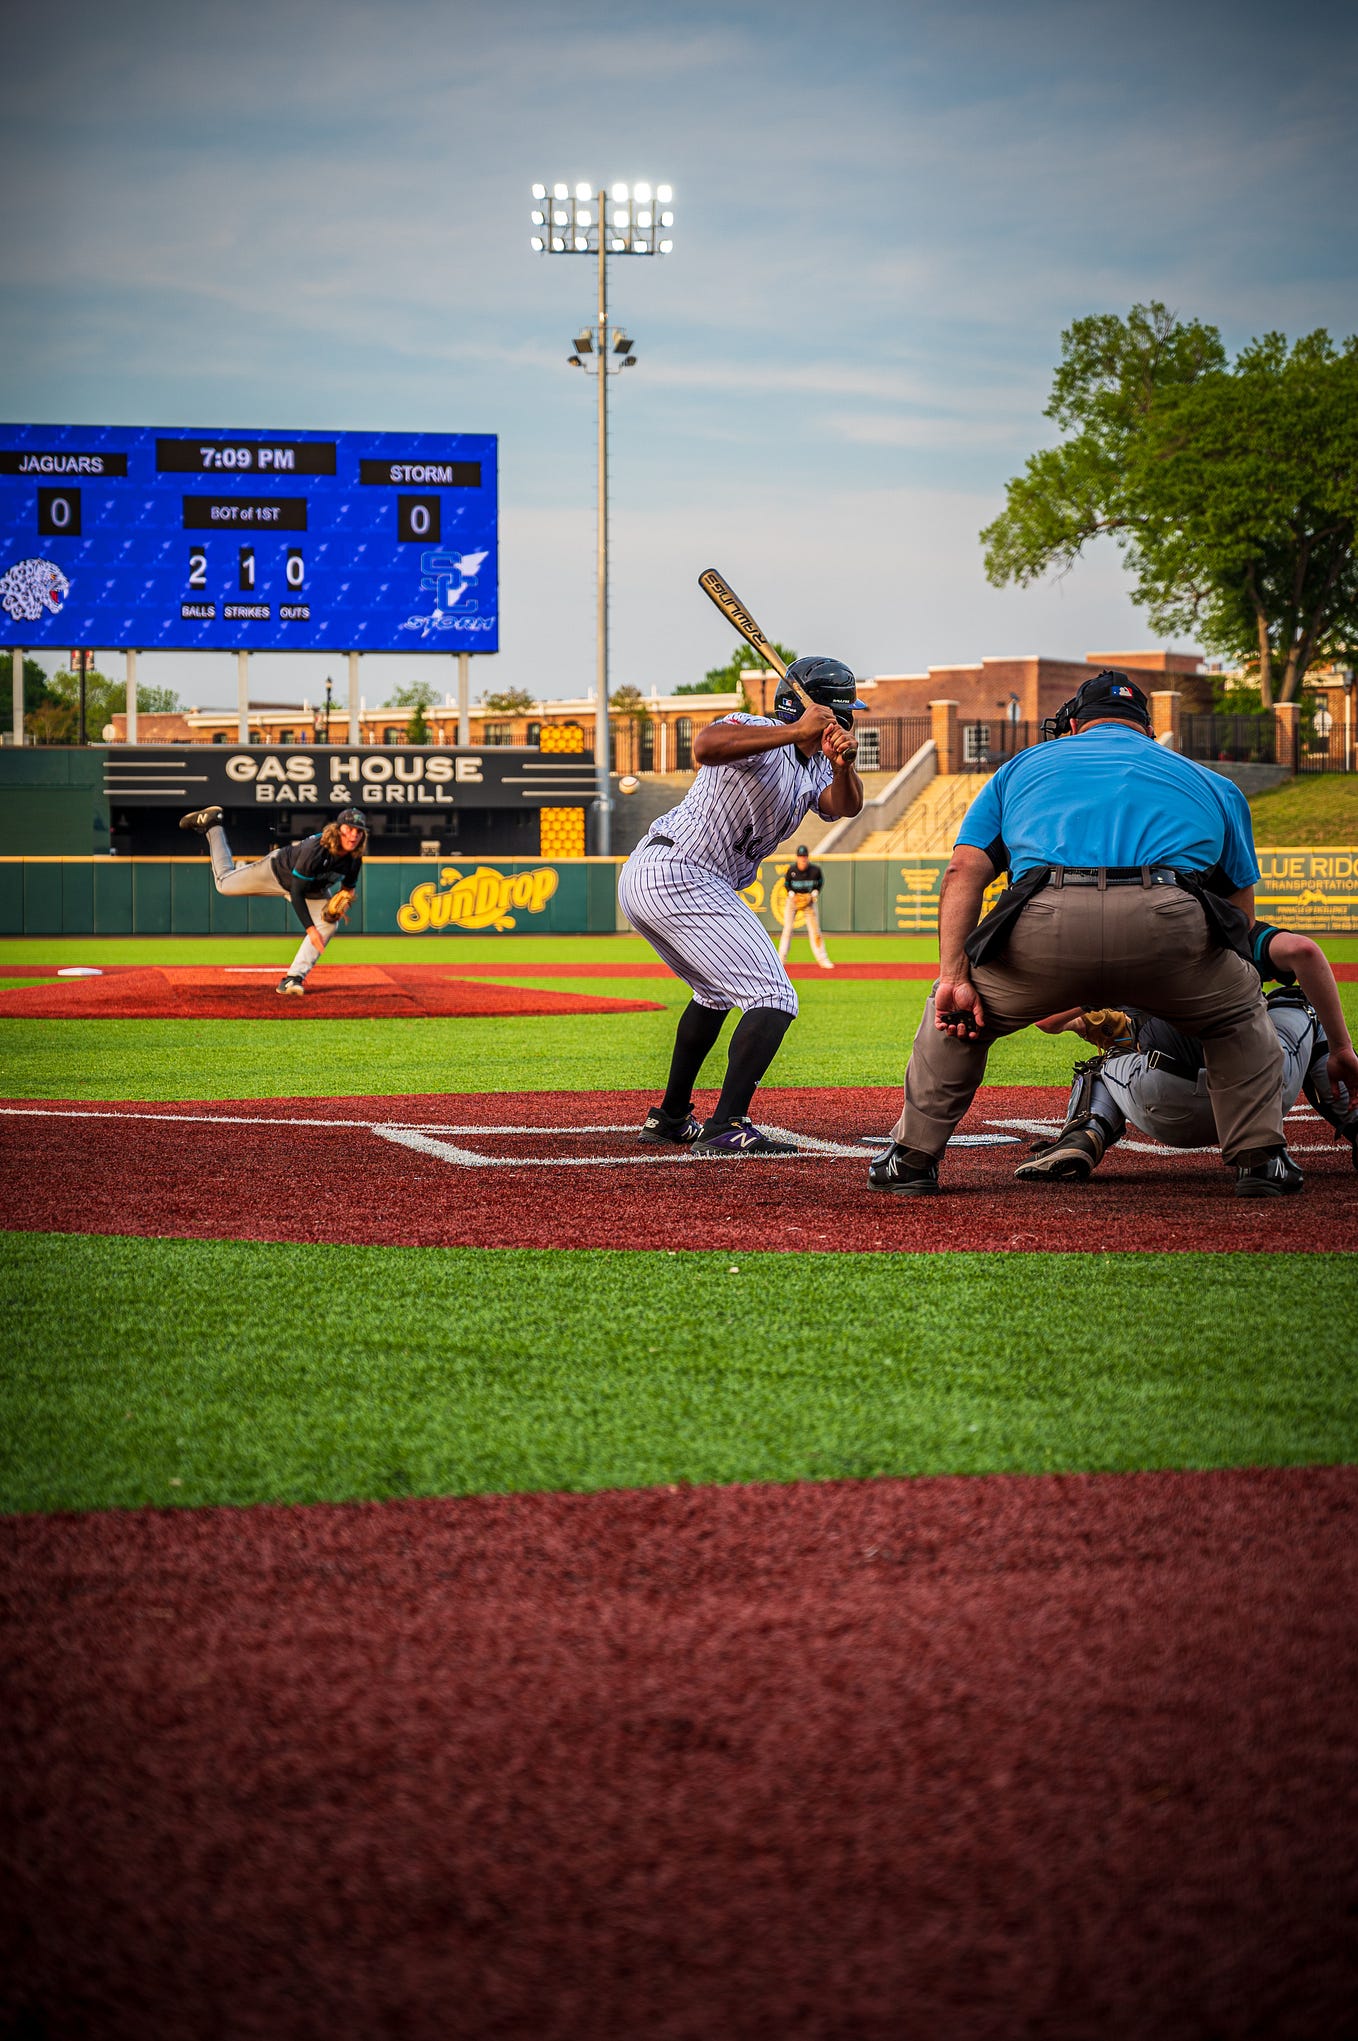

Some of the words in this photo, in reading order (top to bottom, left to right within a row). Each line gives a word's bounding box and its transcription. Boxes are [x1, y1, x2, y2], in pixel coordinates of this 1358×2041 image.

[18, 455, 105, 473] JAGUARS
[200, 447, 252, 468] 7:09
[258, 449, 295, 470] PM
[390, 464, 453, 483] STORM
[51, 497, 71, 528] 0
[210, 505, 239, 520] BOT
[240, 507, 254, 521] of
[255, 507, 281, 521] 1ST
[410, 505, 430, 535] 0
[189, 555, 207, 584] 2
[242, 555, 255, 585] 1
[286, 556, 304, 586] 0
[181, 605, 216, 618] BALLS
[224, 606, 271, 619] STRIKES
[279, 607, 311, 619] OUTS
[704, 574, 768, 647] RAWLINGS
[225, 755, 316, 783] GAS
[329, 756, 484, 783] HOUSE
[256, 784, 318, 803] BAR
[329, 784, 352, 803] &
[362, 785, 454, 804] GRILL
[729, 1132, 757, 1148] N
